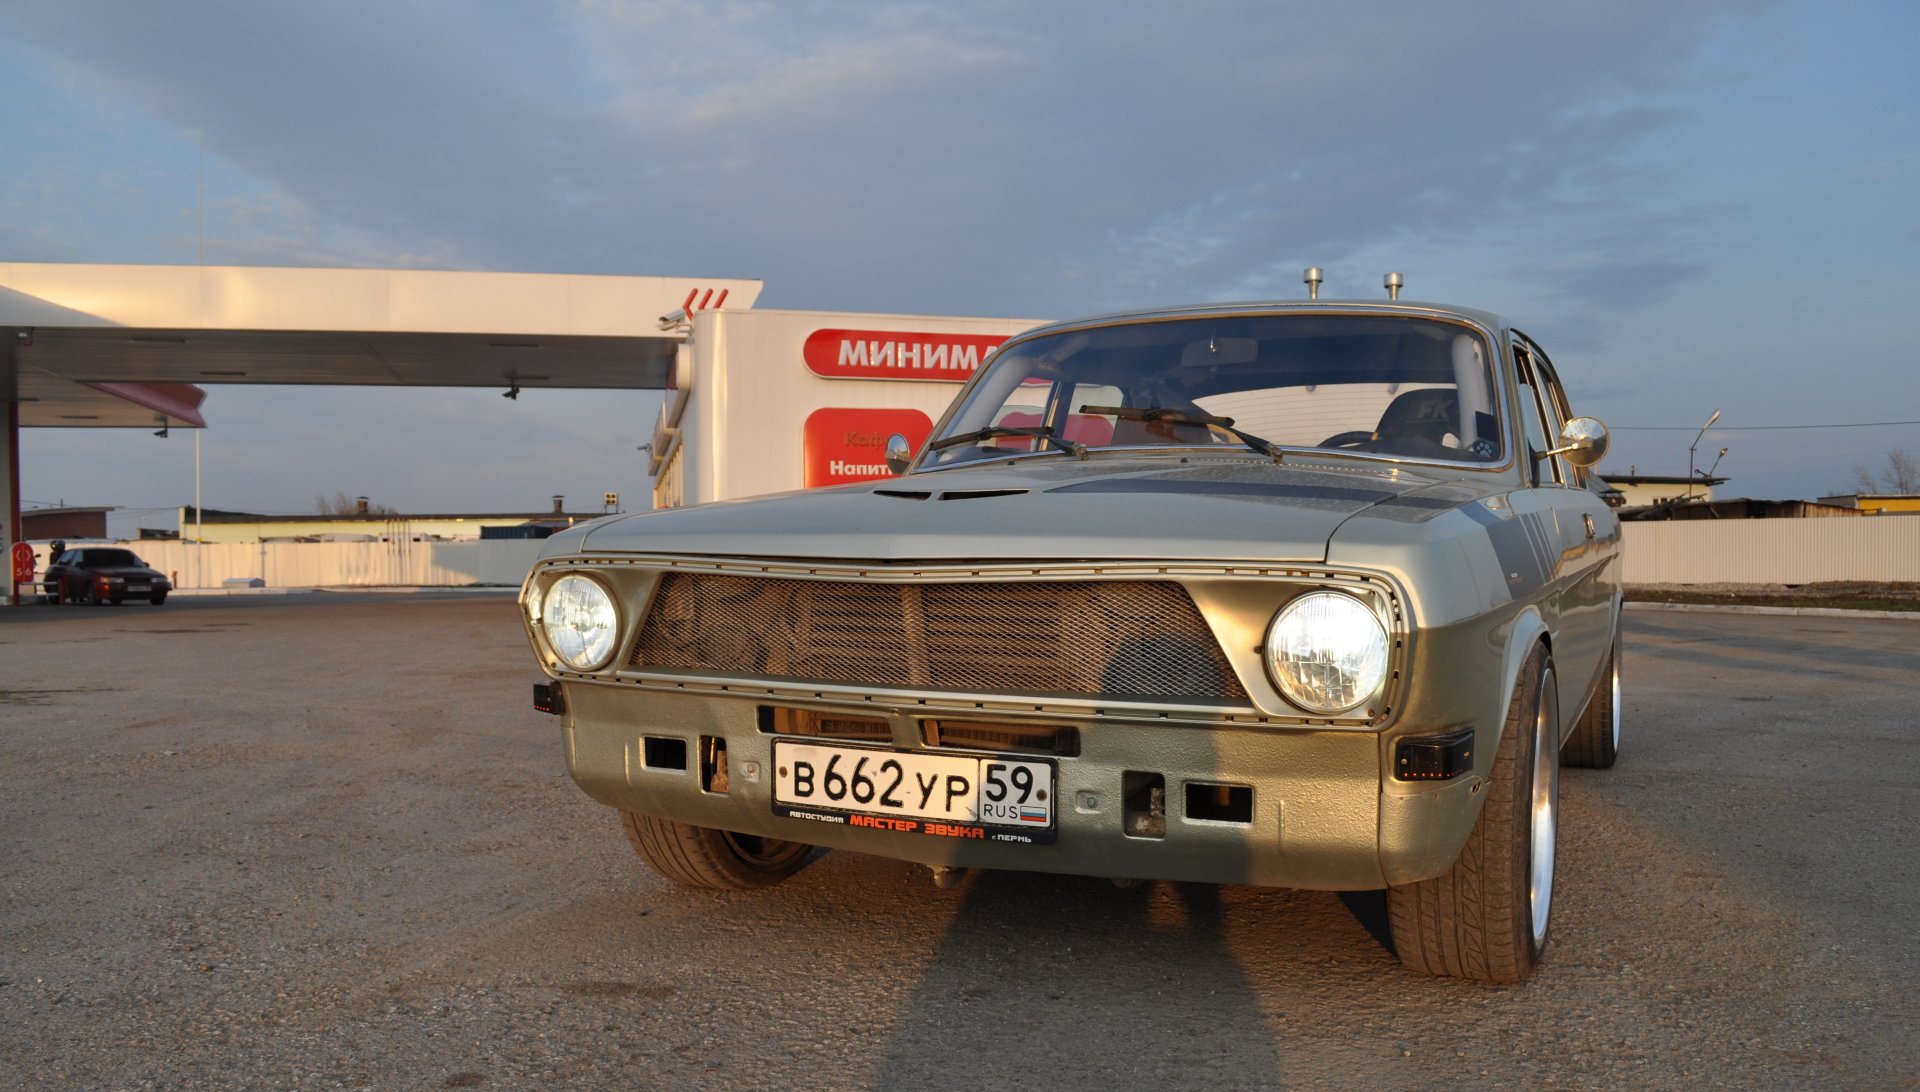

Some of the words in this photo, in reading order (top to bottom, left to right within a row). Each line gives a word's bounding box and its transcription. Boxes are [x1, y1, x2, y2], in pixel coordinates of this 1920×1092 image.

[844, 431, 888, 450] Каф
[985, 763, 1034, 805] 59
[983, 803, 1018, 819] RUS
[789, 810, 844, 824] АВТОСТУДИЯ
[849, 814, 917, 832] МАСТЕР
[924, 822, 985, 839] ЗВУКА
